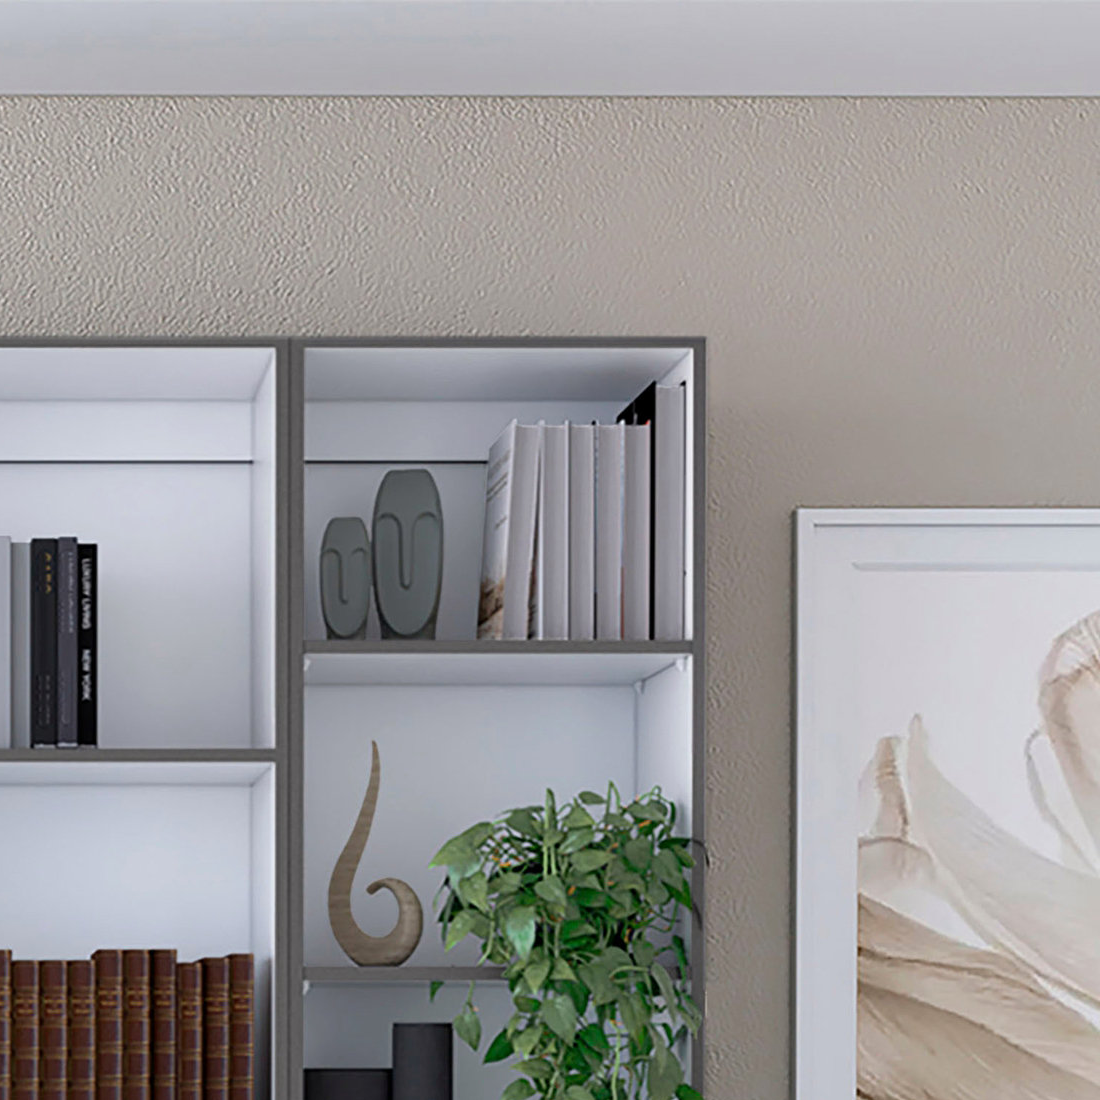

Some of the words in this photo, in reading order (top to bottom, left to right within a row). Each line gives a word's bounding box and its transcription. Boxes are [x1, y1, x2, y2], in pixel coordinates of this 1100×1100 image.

[81, 558, 91, 596] LUXURY
[81, 598, 91, 630] LIVING
[81, 649, 91, 671] NEW
[81, 672, 91, 701] YORK
